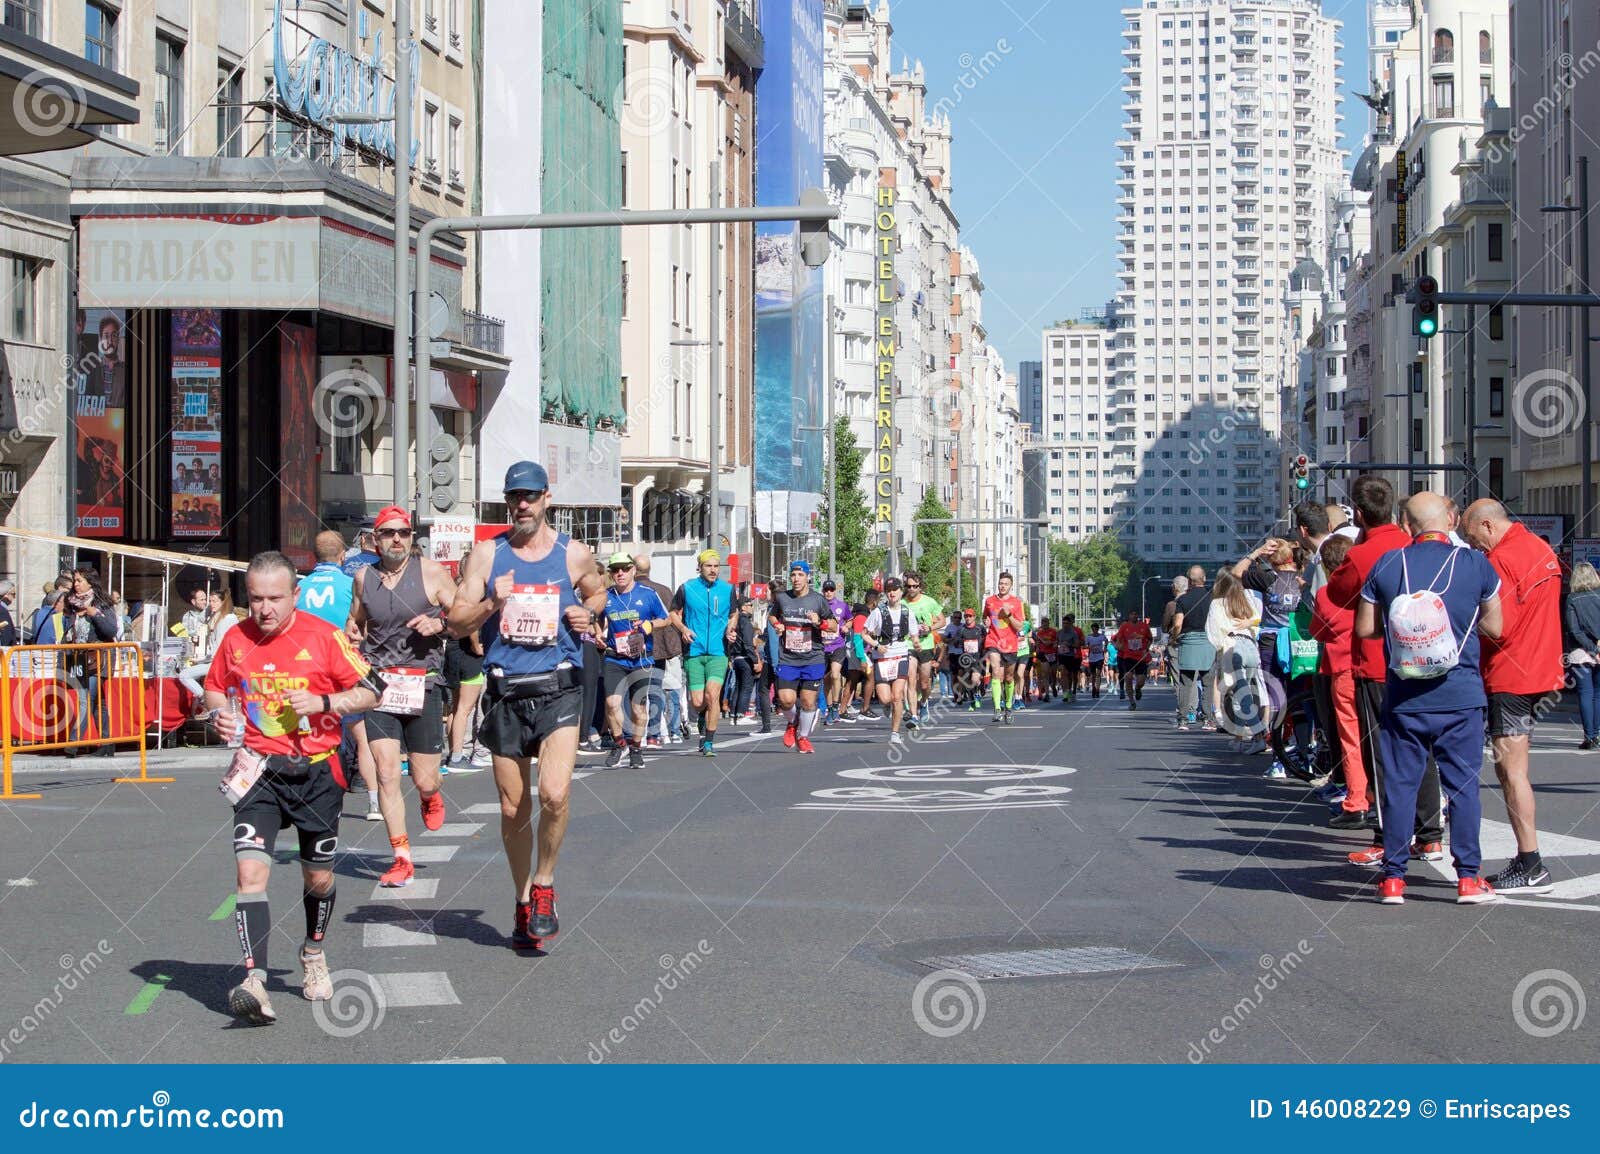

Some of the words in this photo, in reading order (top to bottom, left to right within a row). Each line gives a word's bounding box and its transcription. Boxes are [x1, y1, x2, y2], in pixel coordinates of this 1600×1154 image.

[877, 187, 895, 303] HOTEL
[250, 239, 296, 282] EN
[516, 618, 541, 633] 2777
[389, 692, 409, 705] 2301
